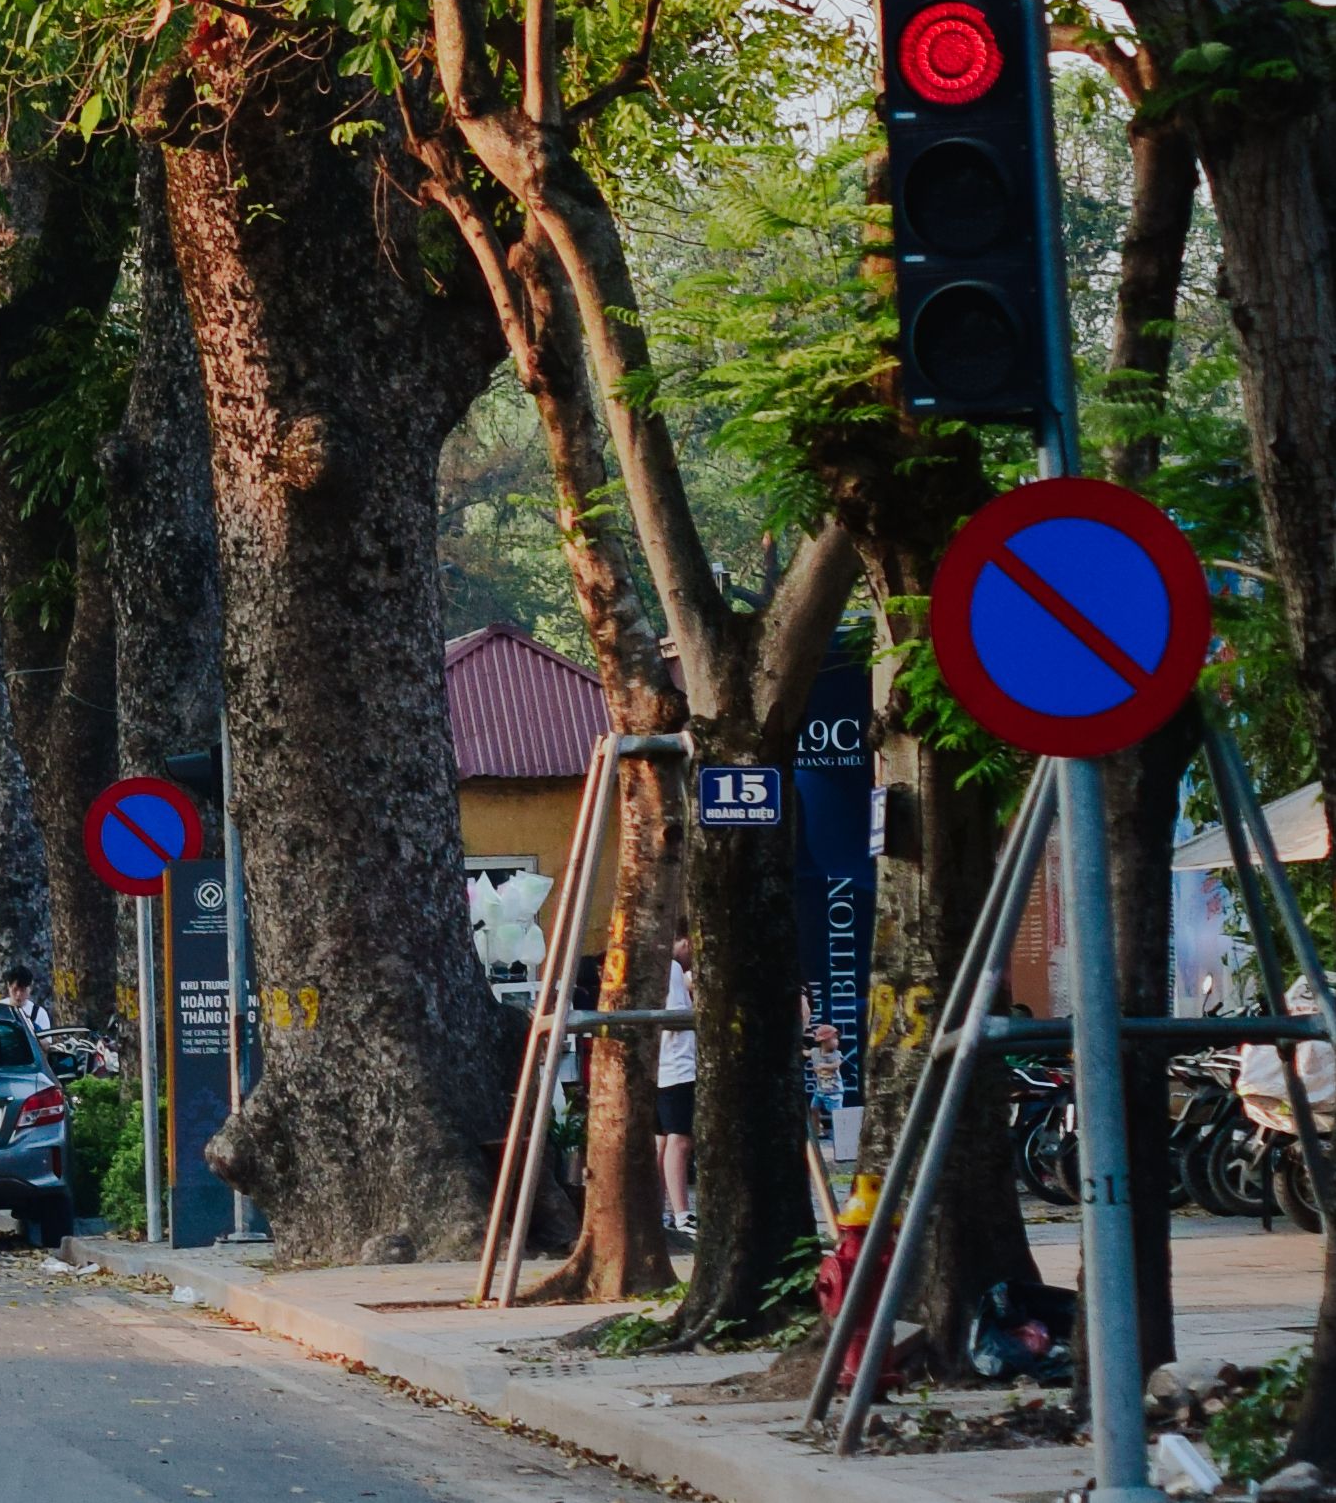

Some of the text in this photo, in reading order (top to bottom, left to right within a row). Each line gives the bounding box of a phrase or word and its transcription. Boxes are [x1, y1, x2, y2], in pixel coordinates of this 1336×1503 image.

[713, 773, 768, 804] 15
[180, 980, 198, 990] KHU
[181, 993, 221, 1008] HOÀNG
[181, 1009, 221, 1024] THĂNG
